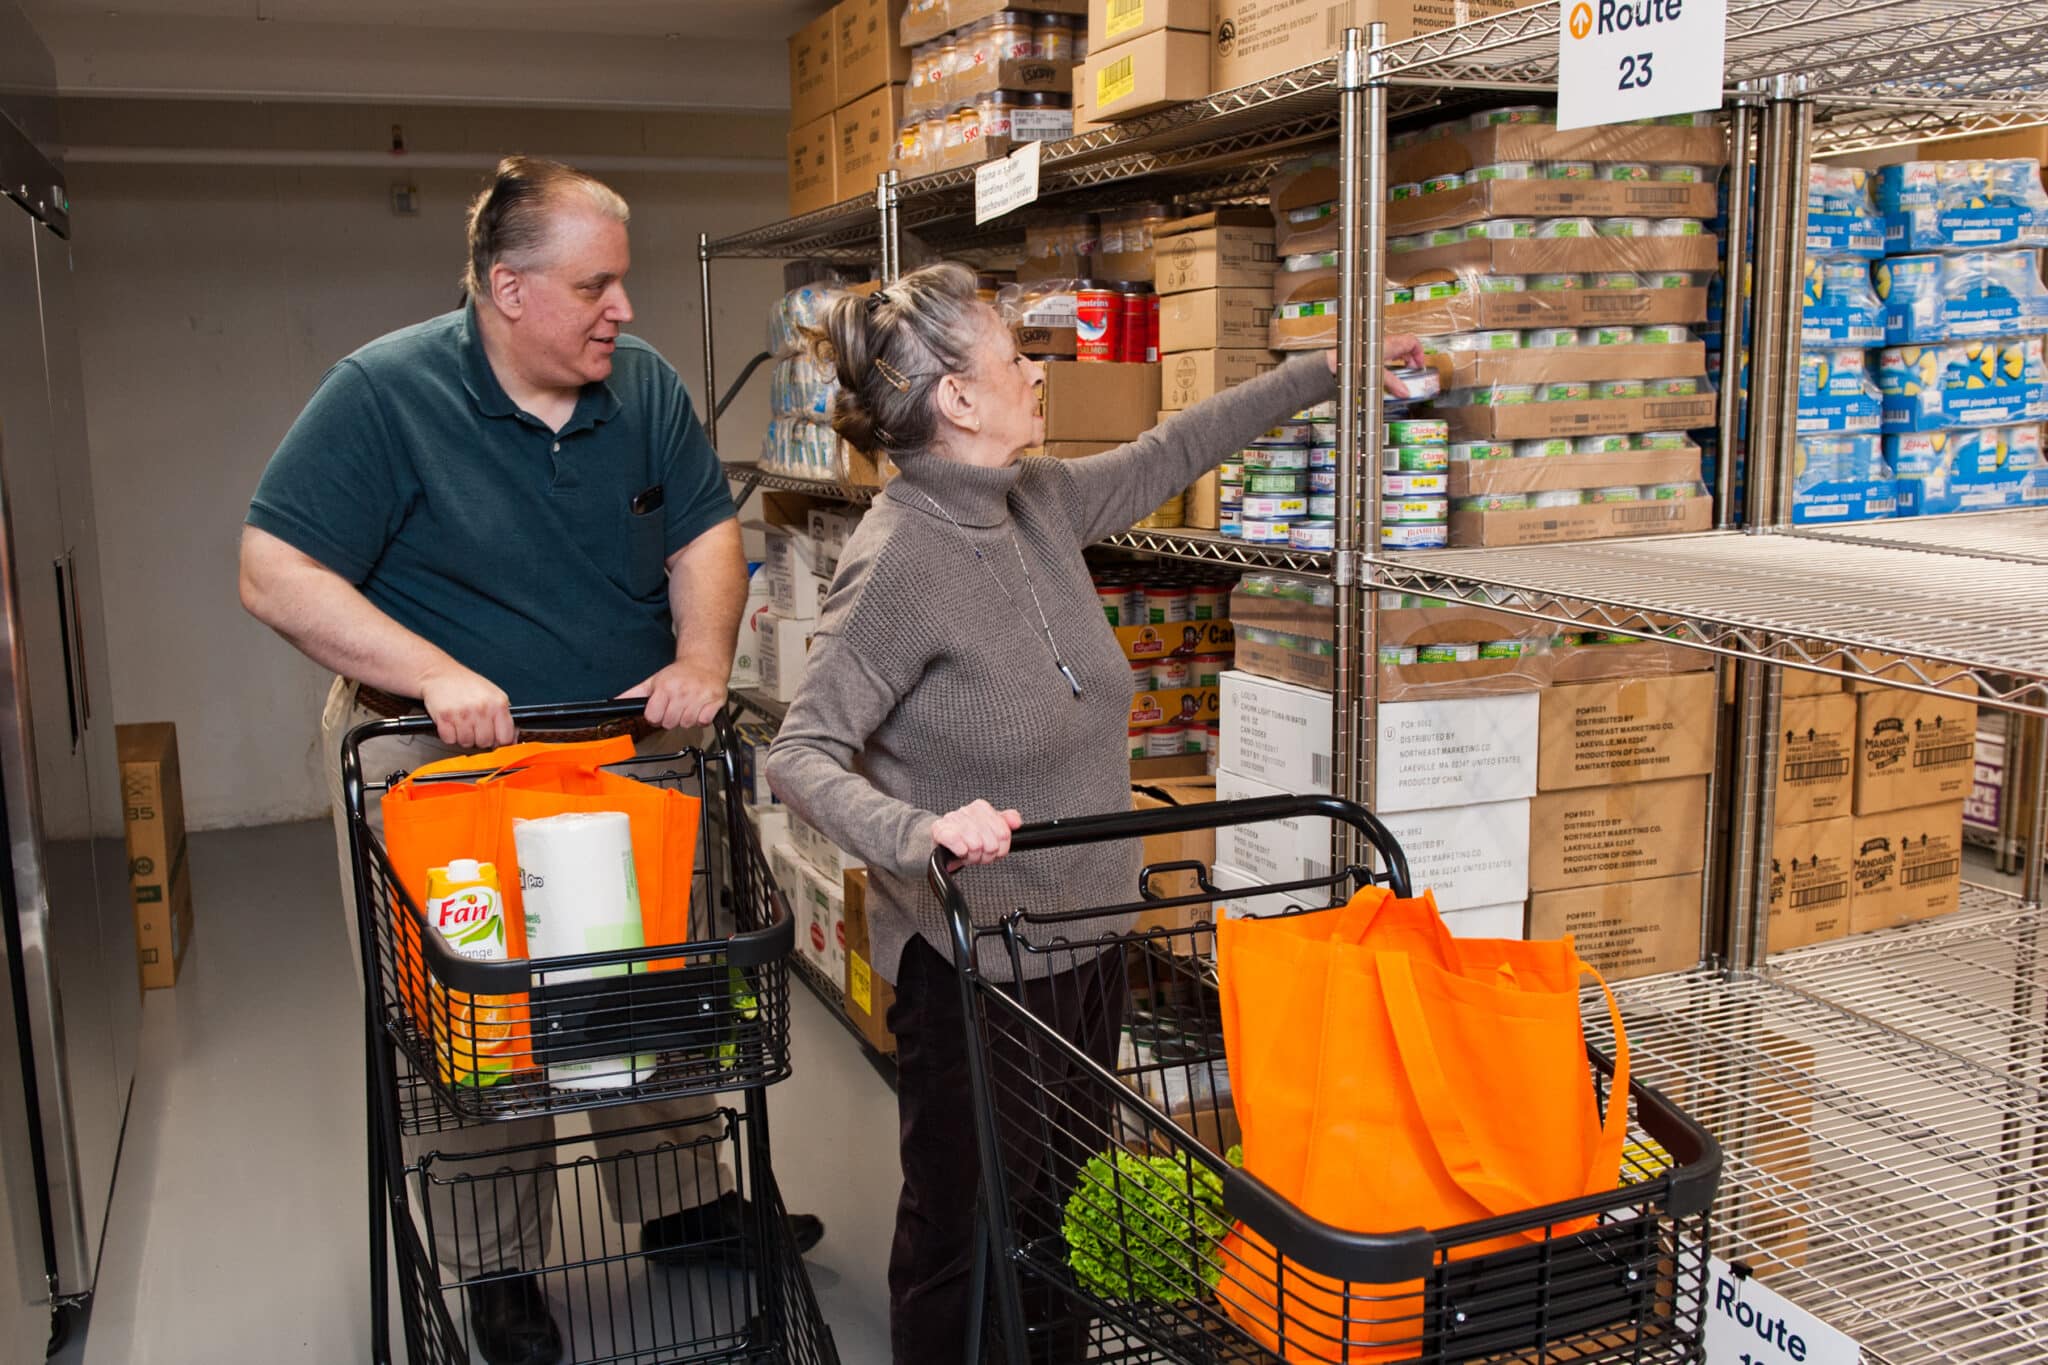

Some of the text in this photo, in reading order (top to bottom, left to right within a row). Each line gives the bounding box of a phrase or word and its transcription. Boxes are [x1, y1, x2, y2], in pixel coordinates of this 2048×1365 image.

[1598, 0, 1682, 35] Route
[1618, 52, 1653, 90] 23
[1901, 193, 1932, 202] CHUNK
[1576, 714, 1634, 726] DISTRIBUTED BY
[1576, 727, 1619, 737] NORTHEAST
[1620, 723, 1661, 734] MARKETING
[1400, 732, 1455, 744] DISTRIBUTED BY
[1628, 735, 1647, 745] 02347
[1865, 732, 1910, 750] MANDARIN
[1400, 748, 1440, 758] NORTHEAST
[1441, 744, 1478, 755] MARKETING
[1576, 746, 1656, 760] PRODUCTION OF CHINA
[1867, 745, 1906, 761] ORANGES
[1439, 761, 1449, 769] MA
[1472, 758, 1496, 767] UNITED
[1497, 755, 1521, 764] STATES
[1576, 761, 1610, 771] SANITARY
[1399, 775, 1463, 787] PRODUCT OF CHINA
[1564, 818, 1622, 831] DISTRIBUTED BY
[1564, 831, 1607, 841] NORTHEAST
[1608, 826, 1649, 837] MARKETING
[1403, 840, 1435, 850] TRIBUTED
[1615, 839, 1635, 847] 02347
[1432, 850, 1470, 861] MARKETING
[1563, 849, 1643, 863] PRODUCTION OF CHINA
[1853, 851, 1896, 869] MANDARIN
[1463, 863, 1487, 872] UNITED
[1488, 860, 1513, 870] STATES
[1563, 865, 1598, 874] SANITARY
[1855, 865, 1893, 881] ORANGES
[528, 873, 544, 889] Pro
[439, 898, 488, 927] Fan
[1566, 920, 1611, 931] DISTRIBUTED
[1575, 931, 1607, 941] RTHEAST
[1609, 926, 1648, 937] MARKETING
[1621, 948, 1643, 957] CHINA
[1715, 1277, 1807, 1362] Route
